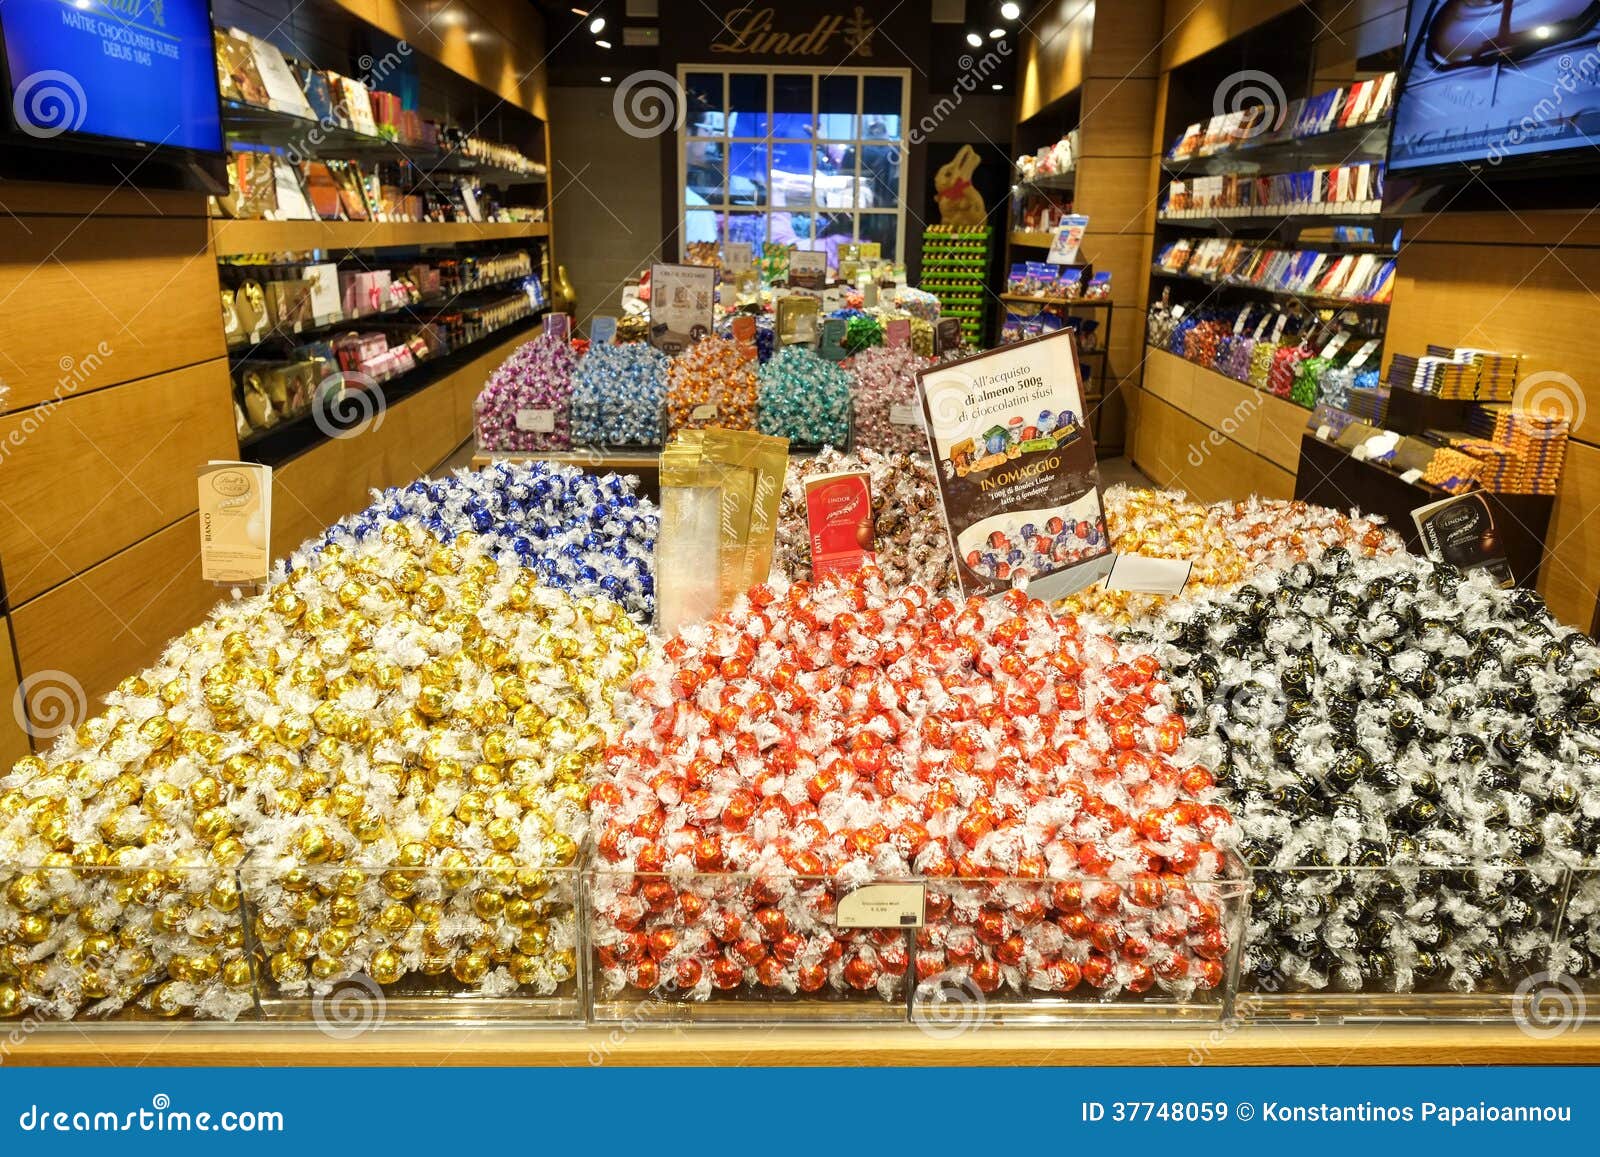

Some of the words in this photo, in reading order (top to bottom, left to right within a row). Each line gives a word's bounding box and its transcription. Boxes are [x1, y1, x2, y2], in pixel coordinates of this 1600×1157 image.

[710, 8, 843, 55] Lindt
[965, 393, 975, 406] di
[978, 385, 1015, 403] almeno
[1017, 376, 1043, 391] 500g
[972, 366, 1031, 389] All'acquisto
[958, 411, 969, 423] di
[971, 393, 1029, 419] cioccolatini
[1031, 384, 1053, 401] sfusi
[980, 477, 995, 491] IN
[1035, 474, 1055, 485] Lindor
[754, 469, 776, 523] Lindt
[828, 496, 850, 504] LINDOR
[721, 487, 740, 540] Lindt
[1445, 515, 1469, 527] LINDOR
[1425, 520, 1441, 552] ONDENTE
